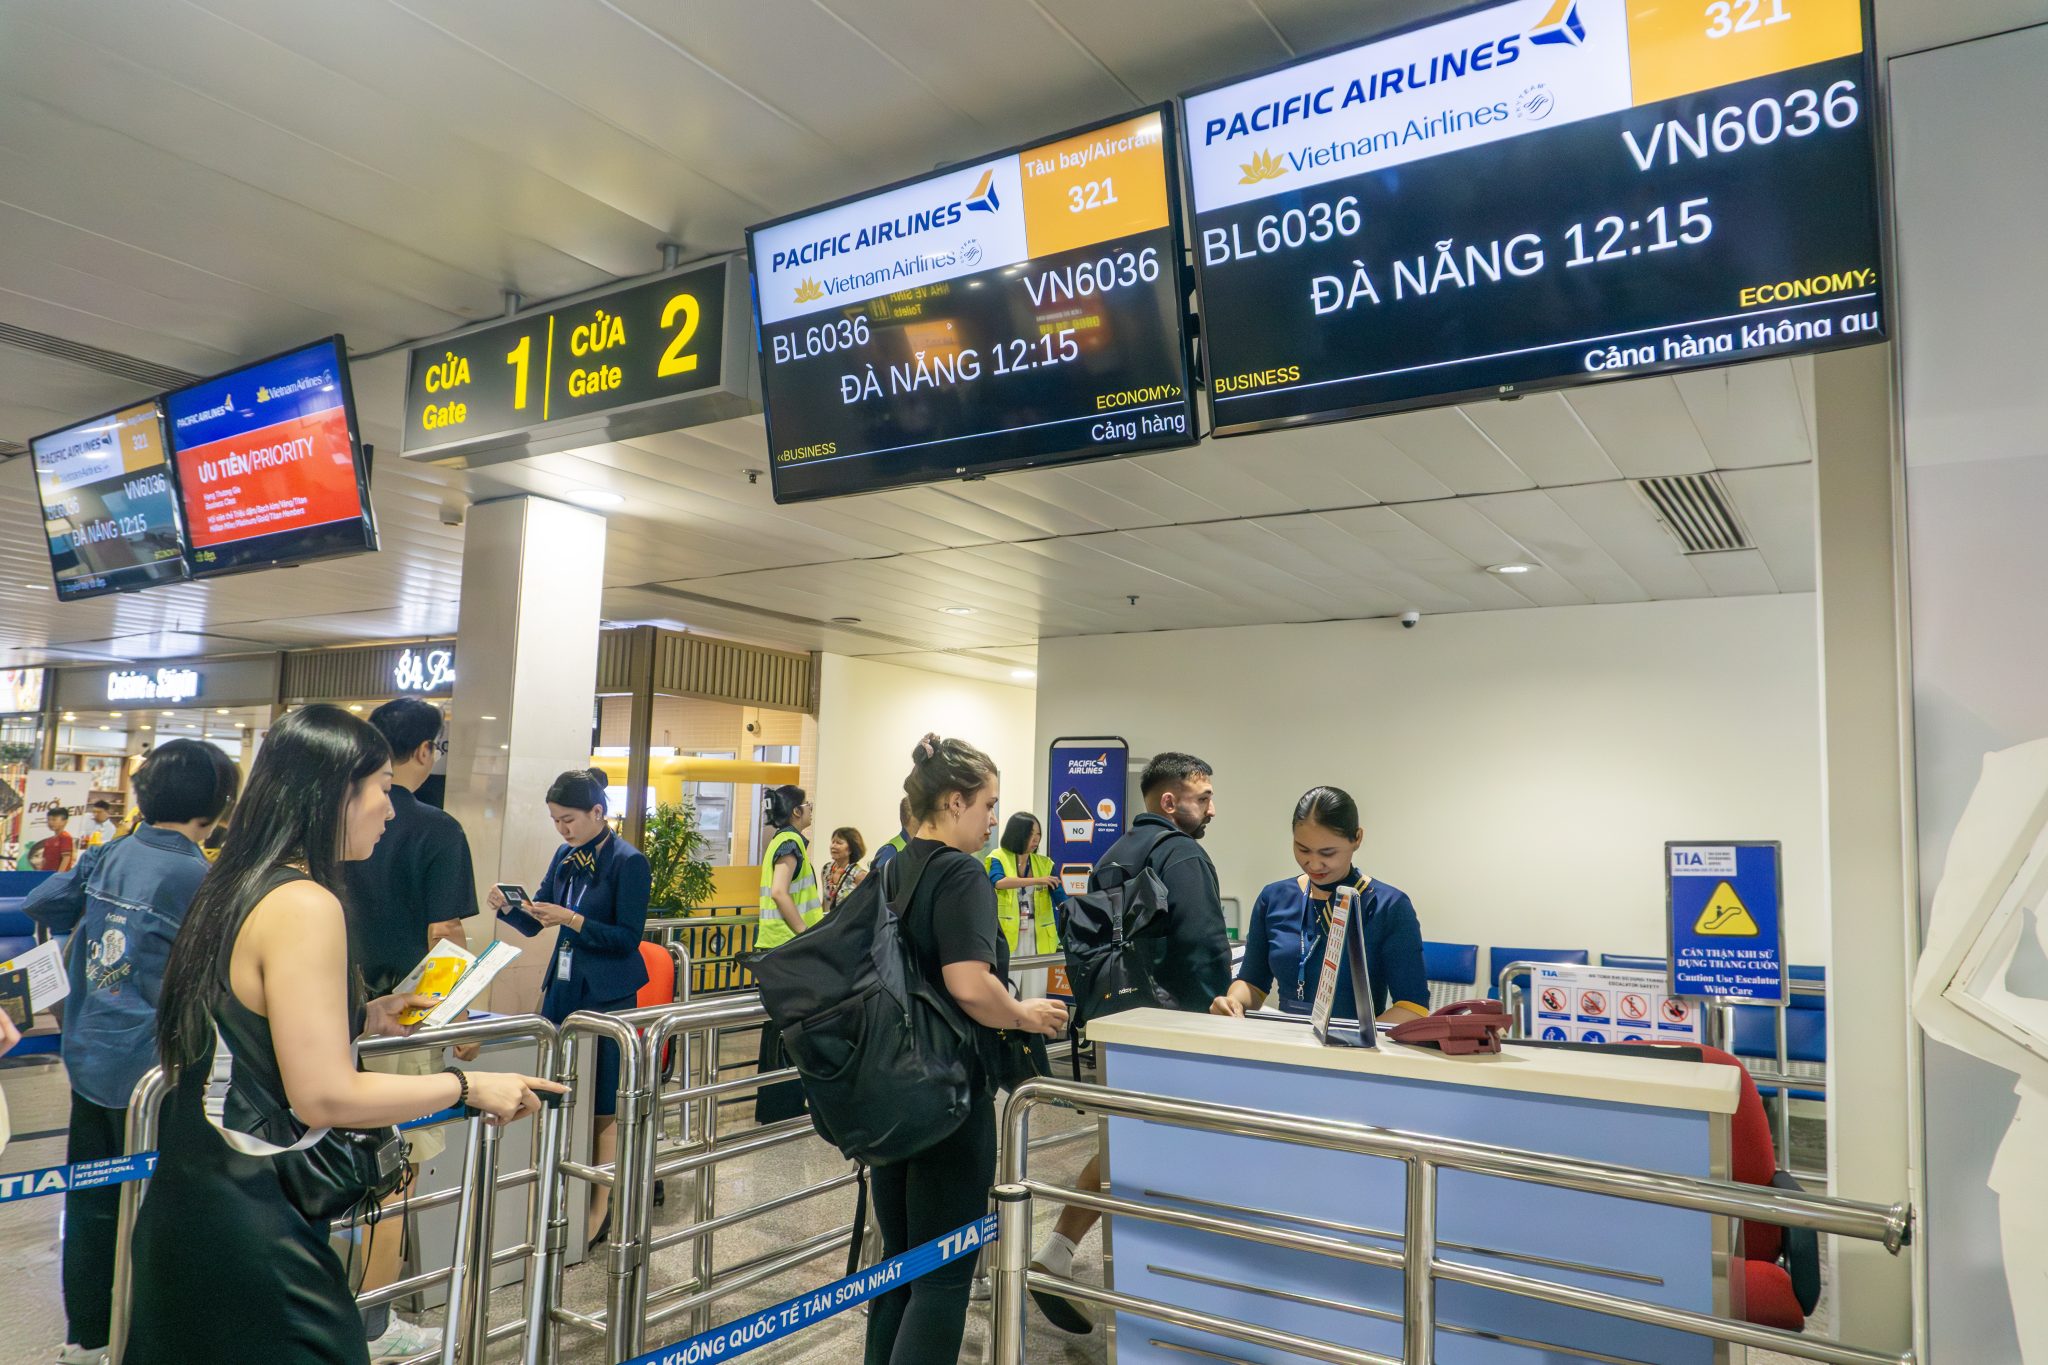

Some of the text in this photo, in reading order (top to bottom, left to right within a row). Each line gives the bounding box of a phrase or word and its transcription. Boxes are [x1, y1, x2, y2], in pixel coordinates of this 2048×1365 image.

[1704, 0, 1791, 39] 321
[1205, 33, 1521, 146] PACIFIC AIRLINES
[1621, 79, 1860, 173] VN6036
[1024, 158, 1055, 178] Tàu
[1068, 176, 1118, 213] 321
[771, 201, 962, 274] PACIFIC AIRLINES
[1203, 195, 1362, 267] BL6036
[1310, 197, 1714, 316] ĐÀ NẴNG 12:15
[1023, 246, 1160, 307] VN6036
[1739, 268, 1871, 308] ECONOMY
[570, 309, 626, 357] CỬA
[657, 293, 700, 378] 2
[773, 314, 870, 364] BL6036
[425, 351, 471, 393] CỬA
[507, 335, 530, 410] 1
[568, 363, 622, 398] Gate
[840, 328, 1080, 404] ĐÀ NẴNG 12:15
[1214, 365, 1300, 395] BUSINESS
[1095, 385, 1171, 410] ECONOMY
[422, 401, 467, 430] Gate
[1091, 413, 1186, 443] Cảng hàng
[784, 442, 837, 463] BUSINESS
[123, 472, 167, 501] VN6036
[118, 513, 148, 537] 12:15
[1068, 759, 1097, 767] PACIFIC
[1068, 767, 1104, 775] AIRLINES
[1072, 827, 1085, 835] NO
[1674, 852, 1703, 866] TIA
[1709, 960, 1747, 969] THANG
[1737, 950, 1757, 959] KHI
[1541, 969, 1558, 977] TIA
[1677, 973, 1780, 985] Caution Use Escalator
[1704, 985, 1753, 996] With Care
[0, 1169, 67, 1199] TIA
[75, 1164, 136, 1180] INTERNATIONAL
[75, 1176, 110, 1188] AIRPORT
[937, 1225, 981, 1262] TIA
[662, 1261, 904, 1365] KHÔNG QUỐC TẾ TÂN SƠN NHẤT
